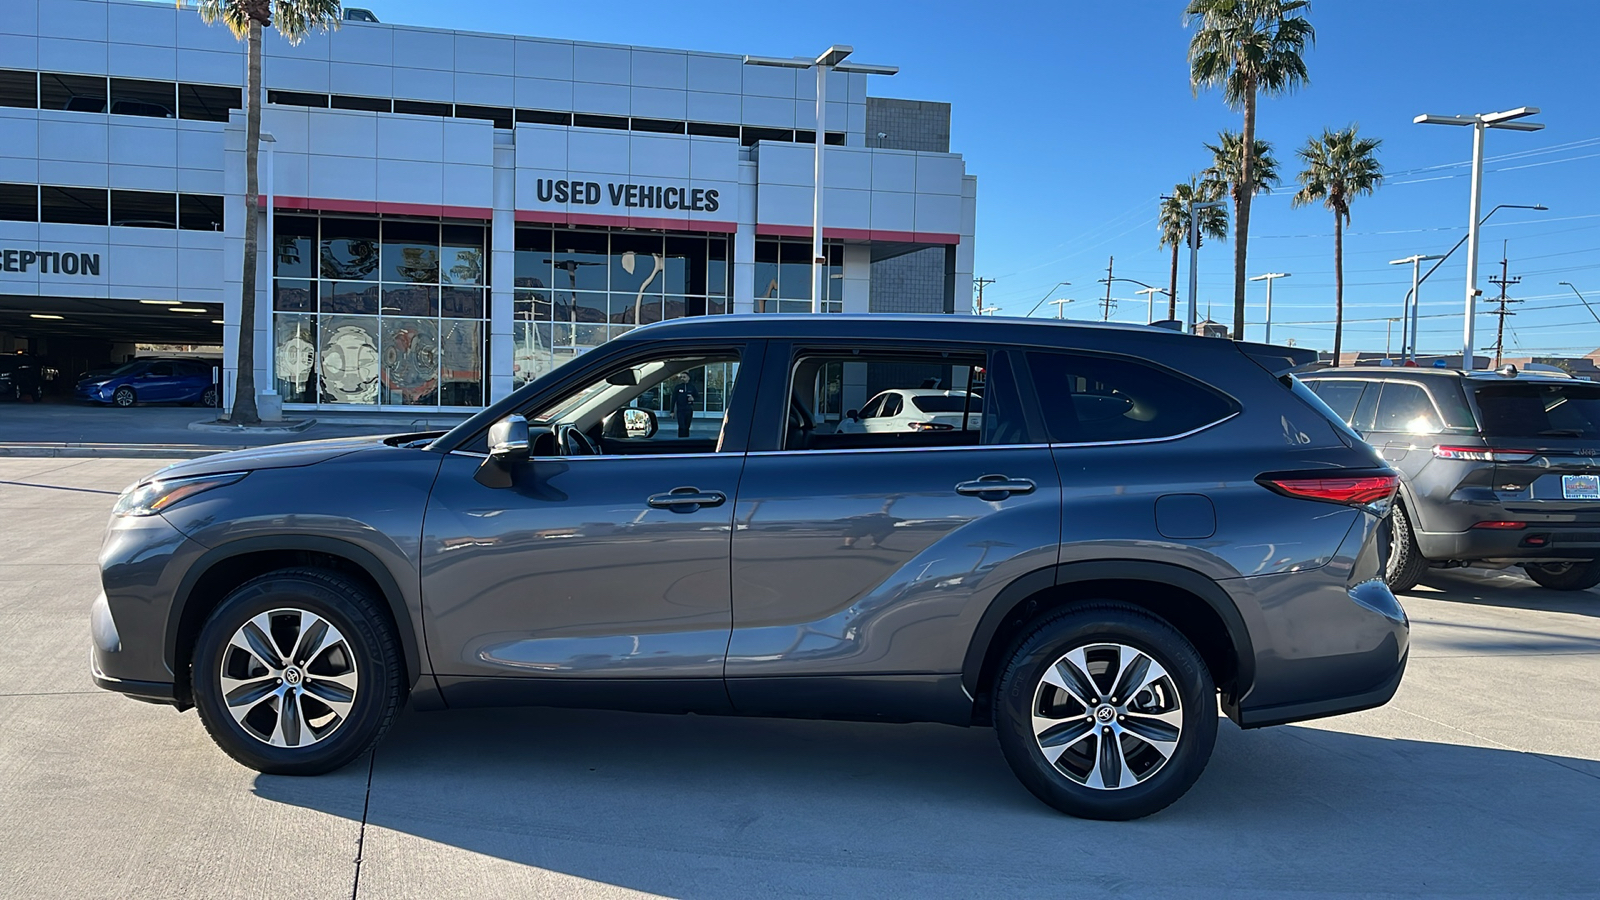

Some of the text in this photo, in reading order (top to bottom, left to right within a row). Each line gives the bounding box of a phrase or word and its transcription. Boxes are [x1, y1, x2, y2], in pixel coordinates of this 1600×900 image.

[537, 179, 720, 212] USED VEHICLES
[0, 249, 100, 276] EPTION
